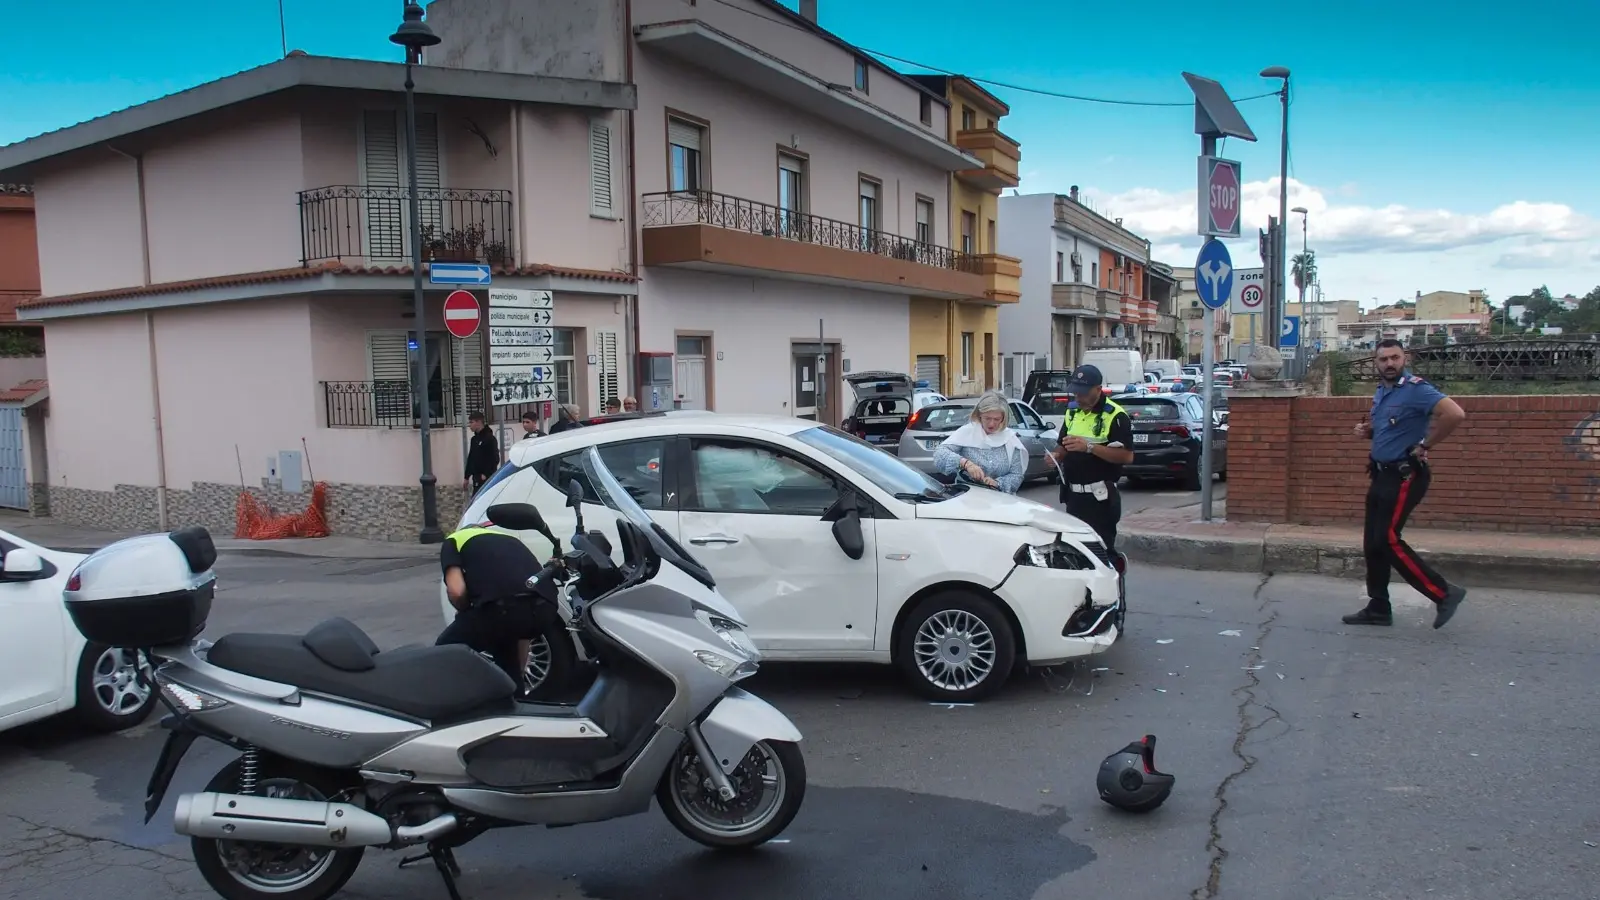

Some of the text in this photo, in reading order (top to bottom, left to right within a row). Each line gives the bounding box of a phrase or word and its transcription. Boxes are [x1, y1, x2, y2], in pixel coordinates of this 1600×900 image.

[1211, 184, 1236, 210] STOP
[1240, 273, 1264, 281] zona
[490, 293, 517, 301] municipio
[1246, 291, 1259, 301] 30
[490, 312, 530, 321] polizia municipale
[491, 350, 531, 359] impianti sportivi
